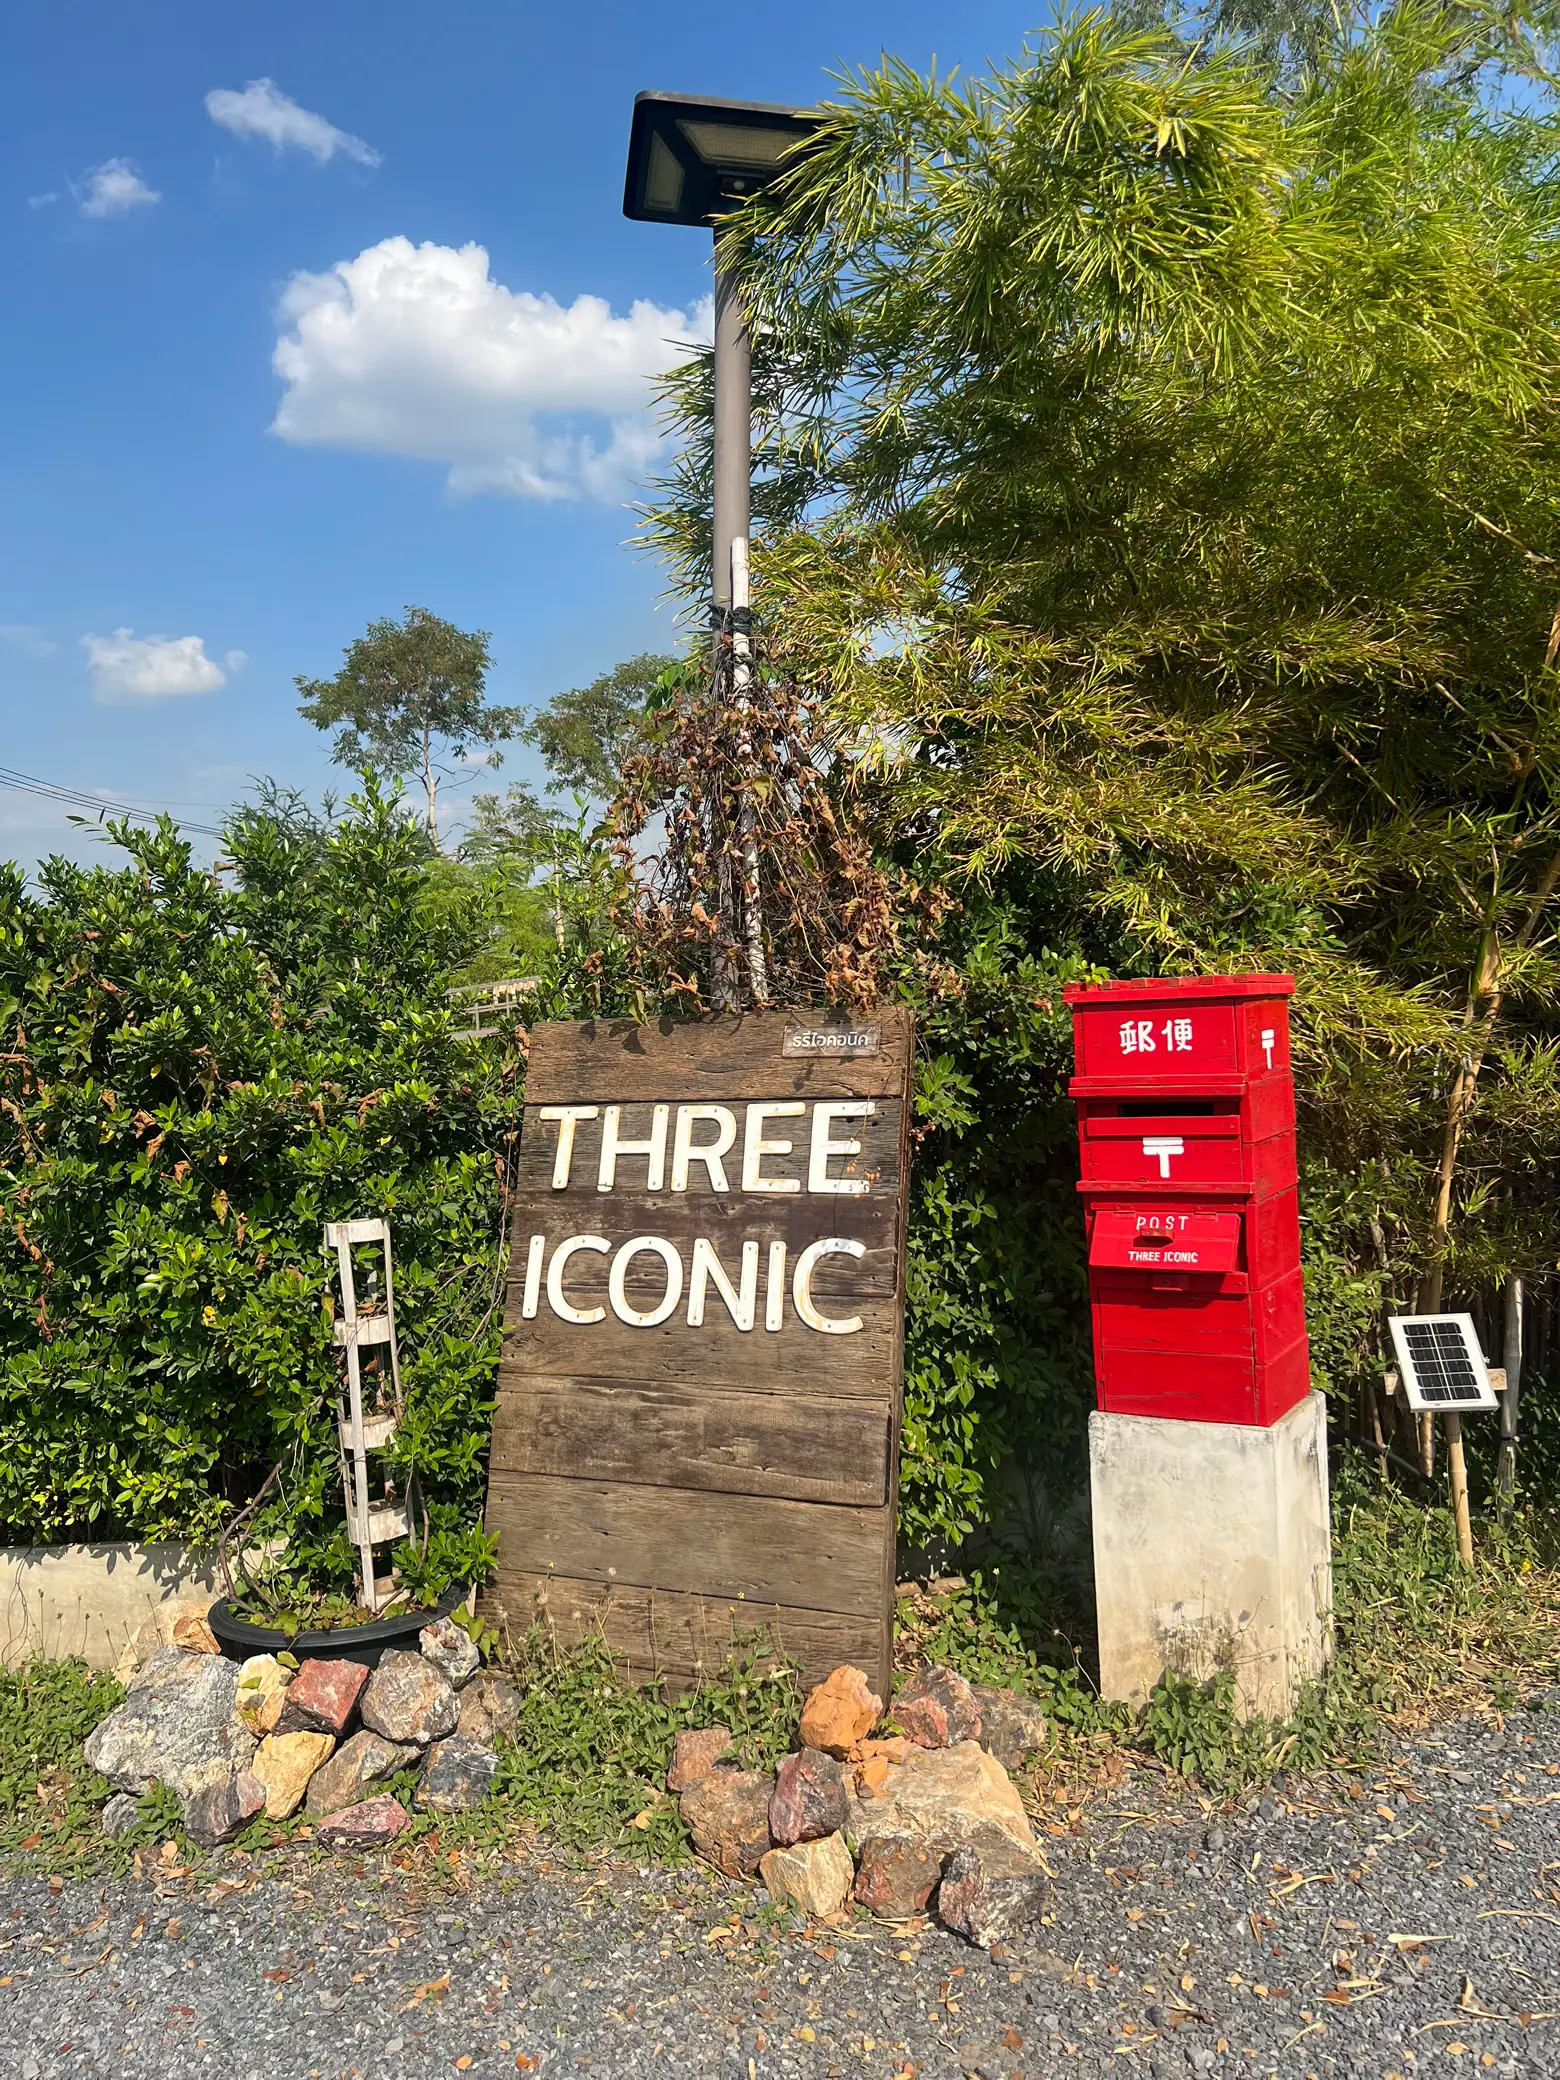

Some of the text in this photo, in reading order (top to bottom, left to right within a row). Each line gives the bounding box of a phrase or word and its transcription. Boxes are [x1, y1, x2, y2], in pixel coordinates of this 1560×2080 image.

[1118, 1018, 1193, 1055] 郵便
[539, 1102, 876, 1193] THREE
[1135, 1215, 1189, 1231] POST
[1128, 1251, 1199, 1263] THREE ICONIC
[521, 1234, 867, 1335] ICONIC
